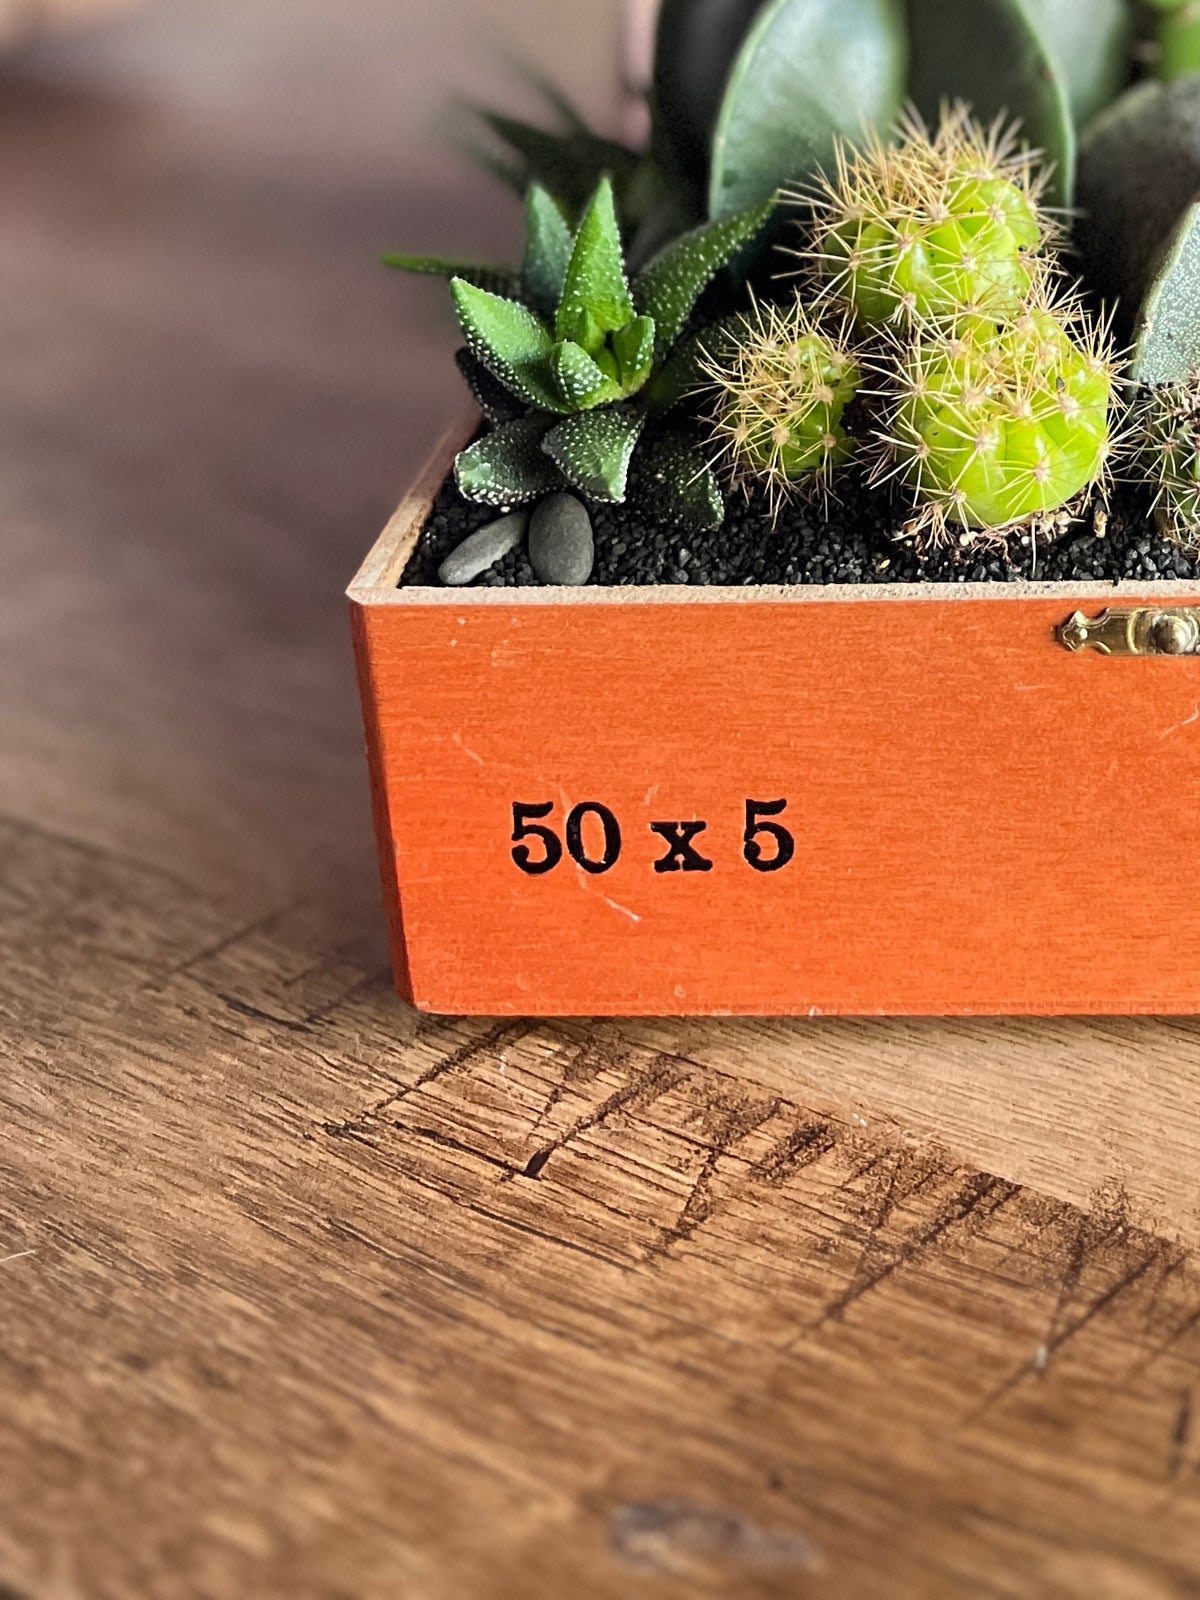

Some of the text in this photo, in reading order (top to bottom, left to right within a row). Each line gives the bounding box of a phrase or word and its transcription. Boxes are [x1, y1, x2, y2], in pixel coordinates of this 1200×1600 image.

[511, 798, 795, 874] 50 x 5
